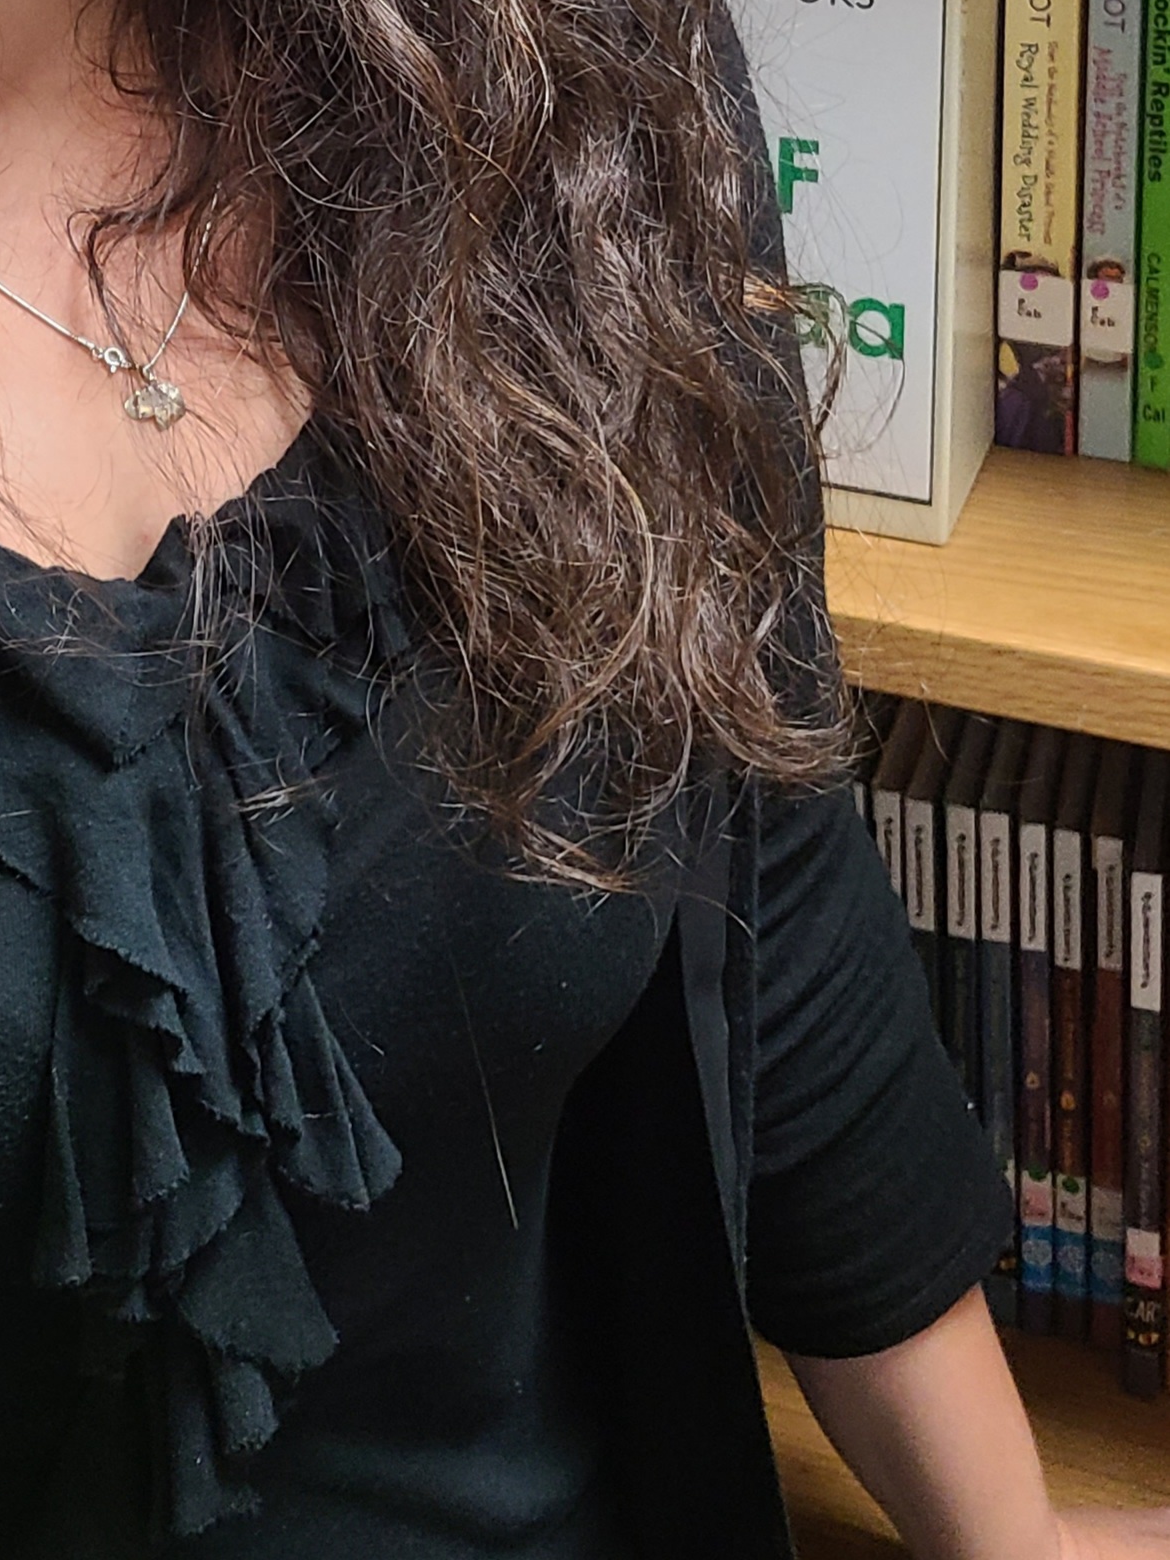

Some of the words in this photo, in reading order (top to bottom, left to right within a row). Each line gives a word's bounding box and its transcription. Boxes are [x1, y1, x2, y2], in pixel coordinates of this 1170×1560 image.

[1016, 42, 1039, 89] Royal
[1093, 45, 1114, 104] Middle
[1013, 96, 1039, 167] Wedding
[1091, 111, 1113, 161] School
[1145, 80, 1170, 184] Reptiles
[778, 136, 819, 215] F
[1016, 174, 1038, 242] Disaster
[1086, 168, 1112, 236] Princess
[1143, 252, 1162, 356] CALMENSO
[1142, 404, 1166, 424] Cal
